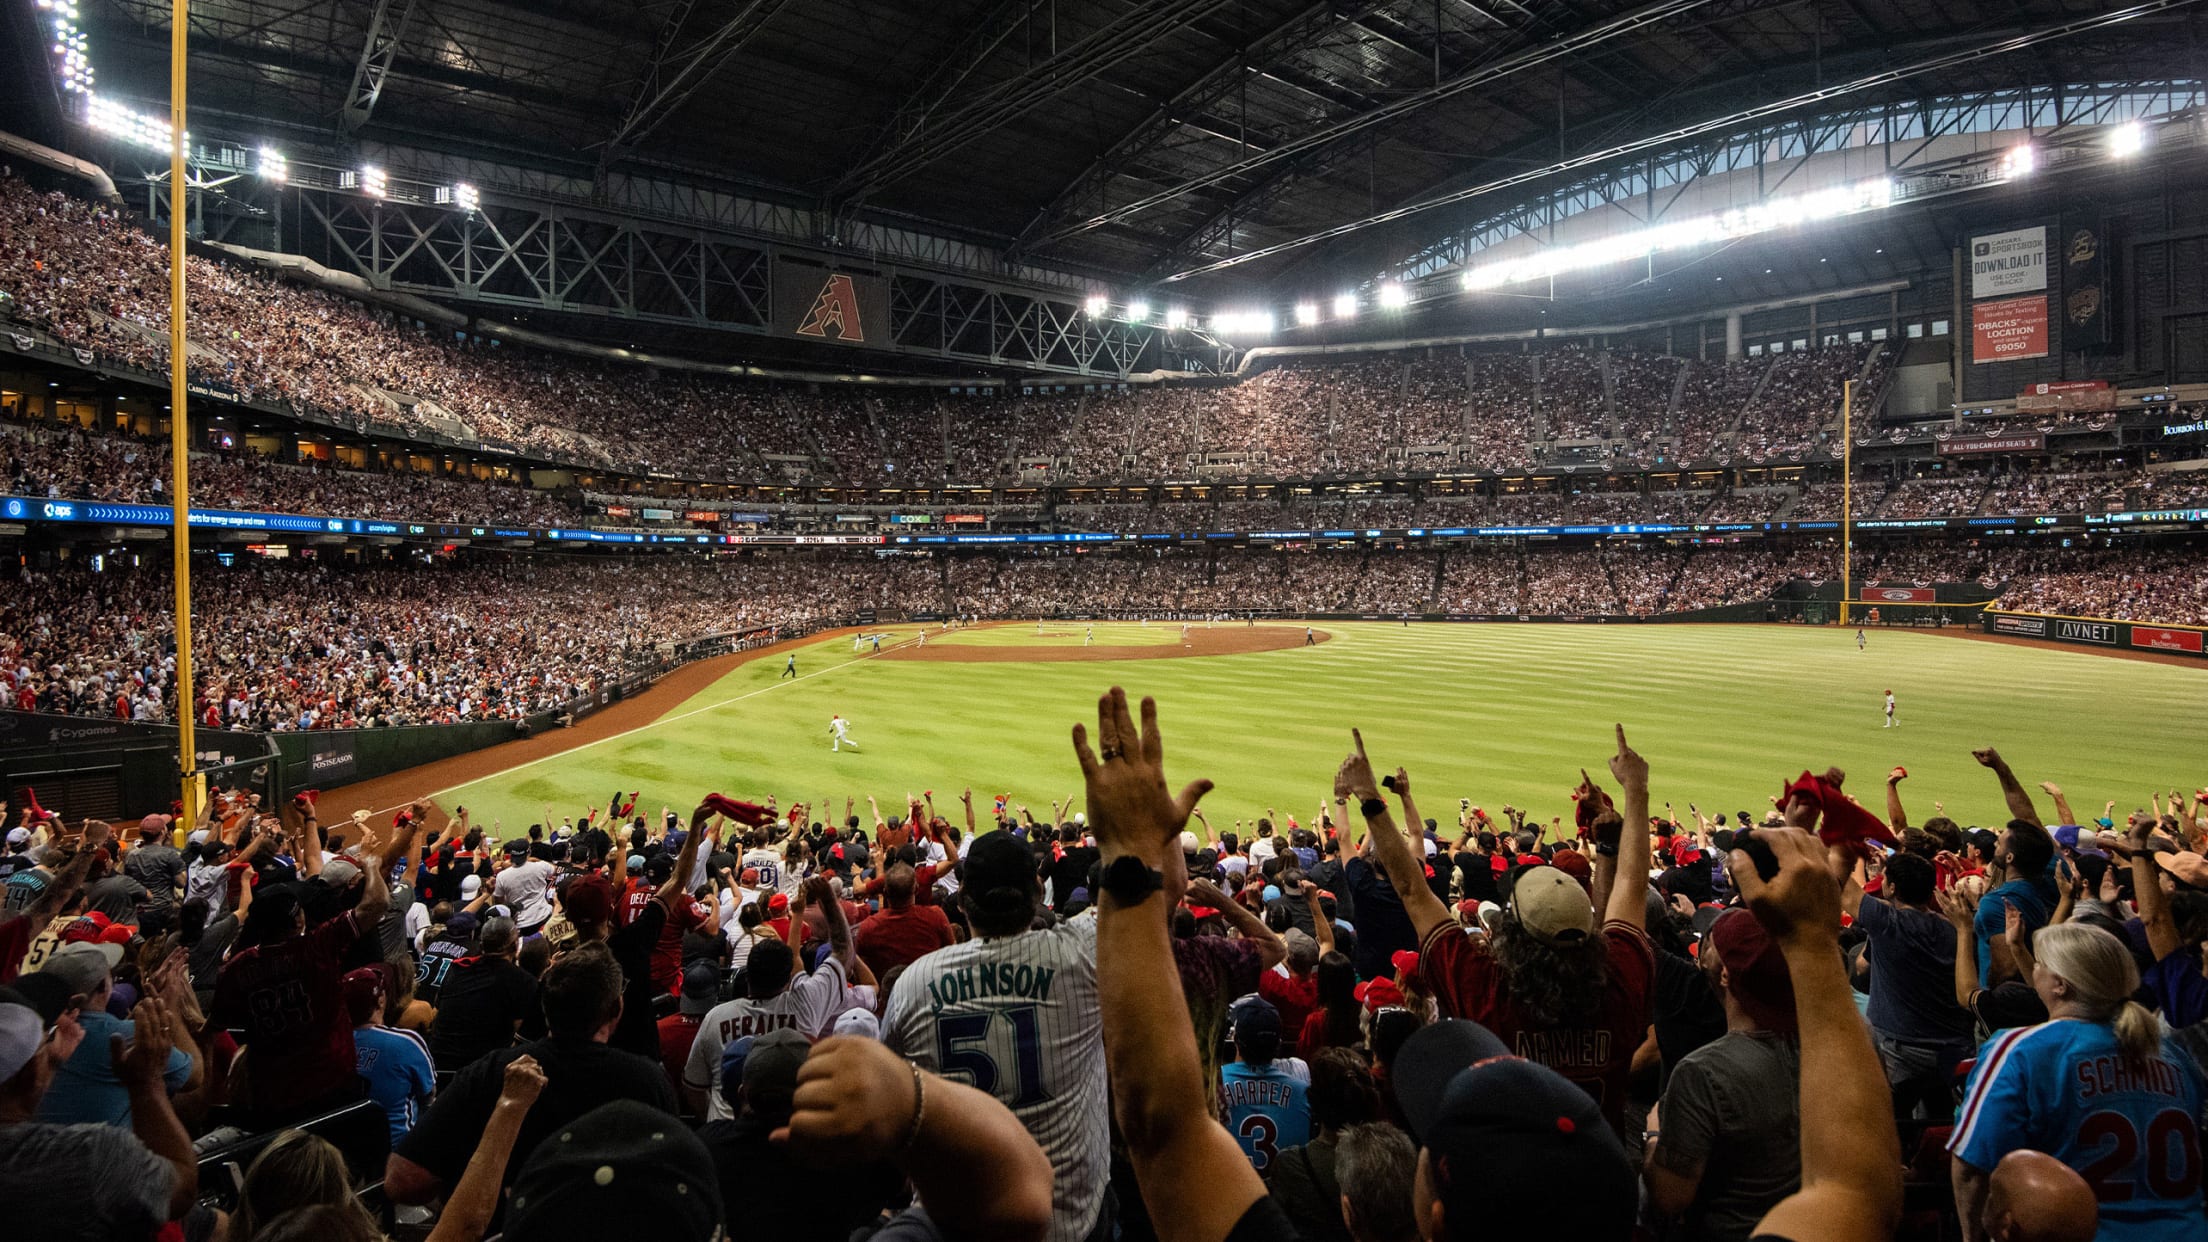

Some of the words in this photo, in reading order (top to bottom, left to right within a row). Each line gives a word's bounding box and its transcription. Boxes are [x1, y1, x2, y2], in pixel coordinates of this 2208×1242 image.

[1992, 240, 2043, 254] SPORTSBOOK
[1974, 254, 2030, 274] DOWNLOAD
[2033, 252, 2044, 266] IT
[1987, 326, 2034, 338] LOCATION
[1995, 341, 2026, 352] 69050
[2196, 420, 2204, 431] &
[2006, 440, 2026, 448] SEATS
[55, 505, 73, 518] aps
[900, 515, 922, 523] COX
[2062, 622, 2109, 640] AVNET
[61, 726, 118, 738] Cygames
[312, 754, 353, 769] POSTSEASON
[414, 954, 454, 988] 51
[928, 961, 1056, 1014] JOHNSON
[935, 1003, 1055, 1111] 51
[2077, 1055, 2186, 1099] SCHMIDT
[1239, 1113, 1280, 1179] 3
[2076, 1107, 2202, 1203] 20
